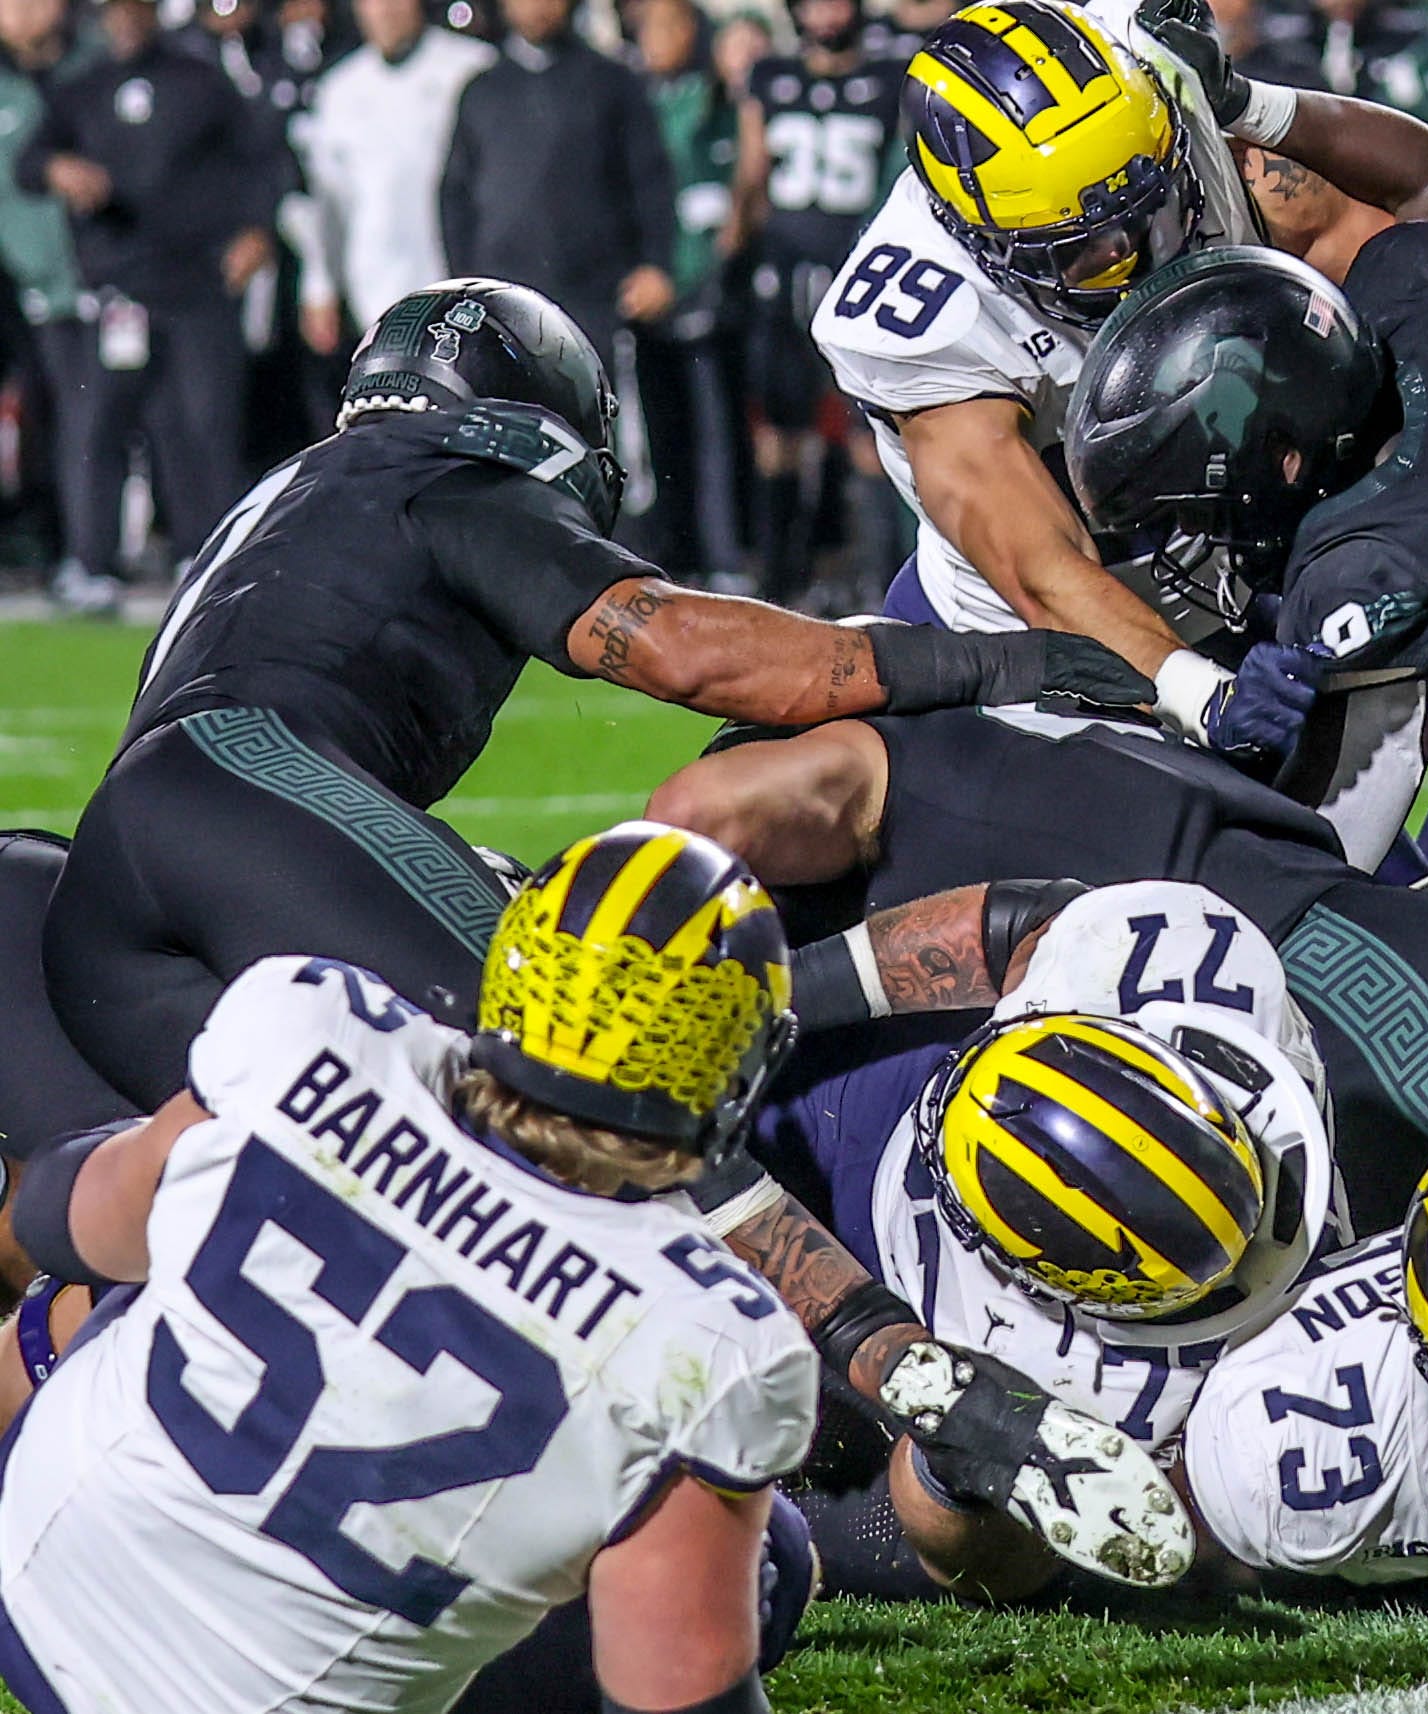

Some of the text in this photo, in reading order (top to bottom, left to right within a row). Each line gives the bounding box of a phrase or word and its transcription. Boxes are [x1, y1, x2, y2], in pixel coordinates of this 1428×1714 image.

[766, 112, 885, 213] 35
[1106, 170, 1129, 193] M
[834, 243, 966, 340] 89
[1118, 912, 1254, 1016] 77
[275, 1047, 643, 1341] BARNHART
[147, 1132, 570, 1629] 52
[1261, 1361, 1384, 1512] 73
